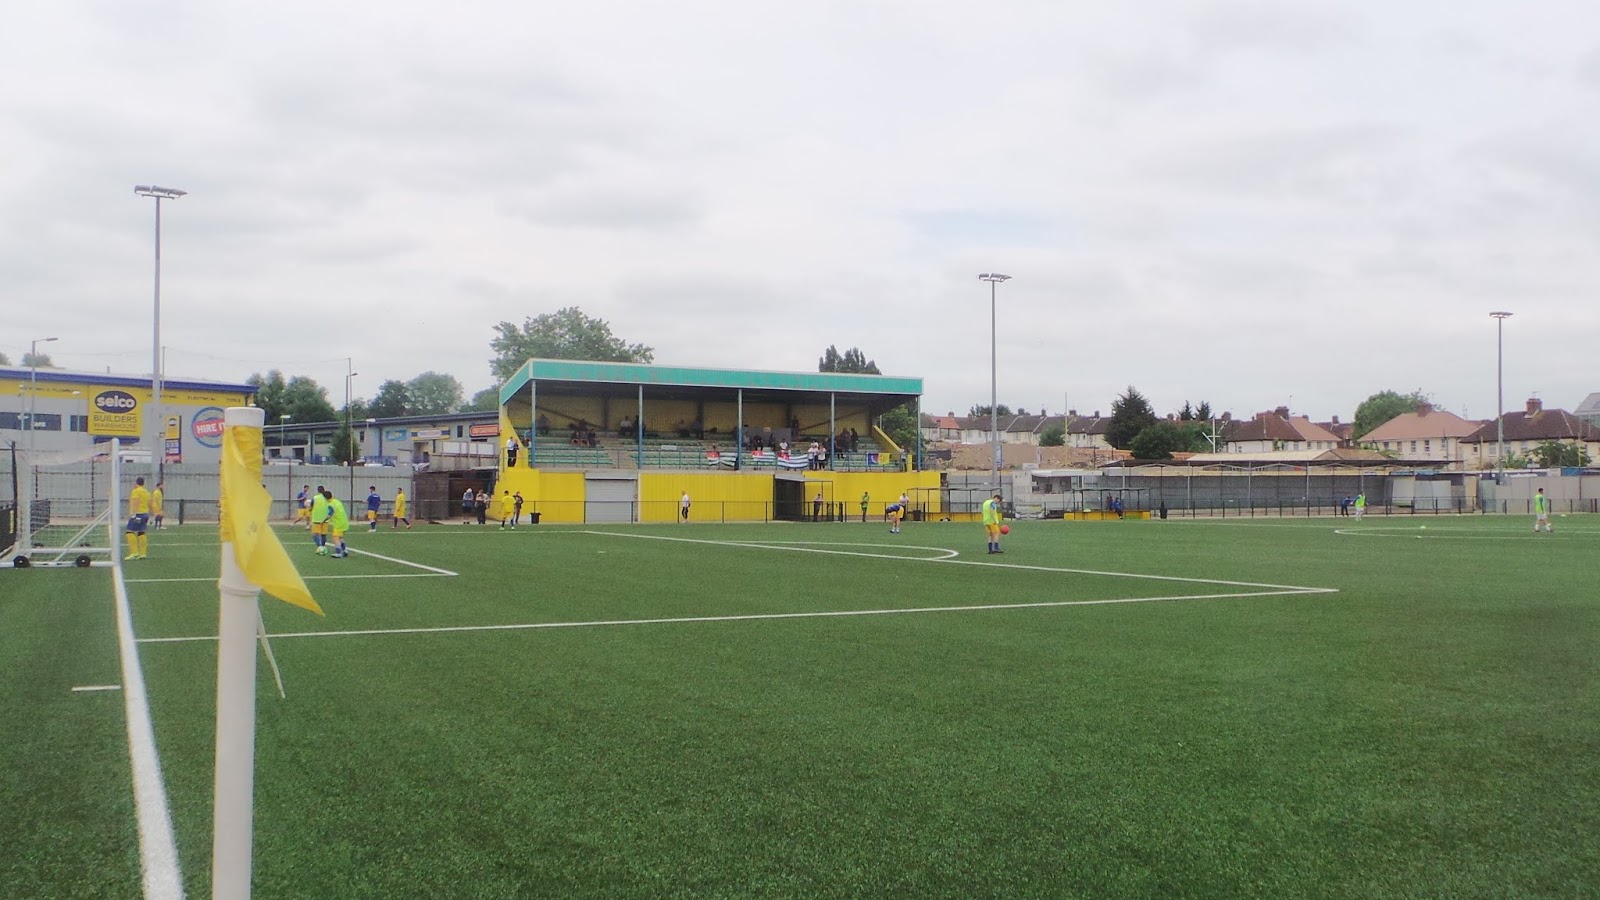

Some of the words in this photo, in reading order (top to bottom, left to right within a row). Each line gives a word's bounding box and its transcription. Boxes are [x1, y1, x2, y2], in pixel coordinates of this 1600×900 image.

[96, 395, 135, 408] selco
[94, 415, 137, 423] BUILDERS
[196, 423, 217, 434] HIRE
